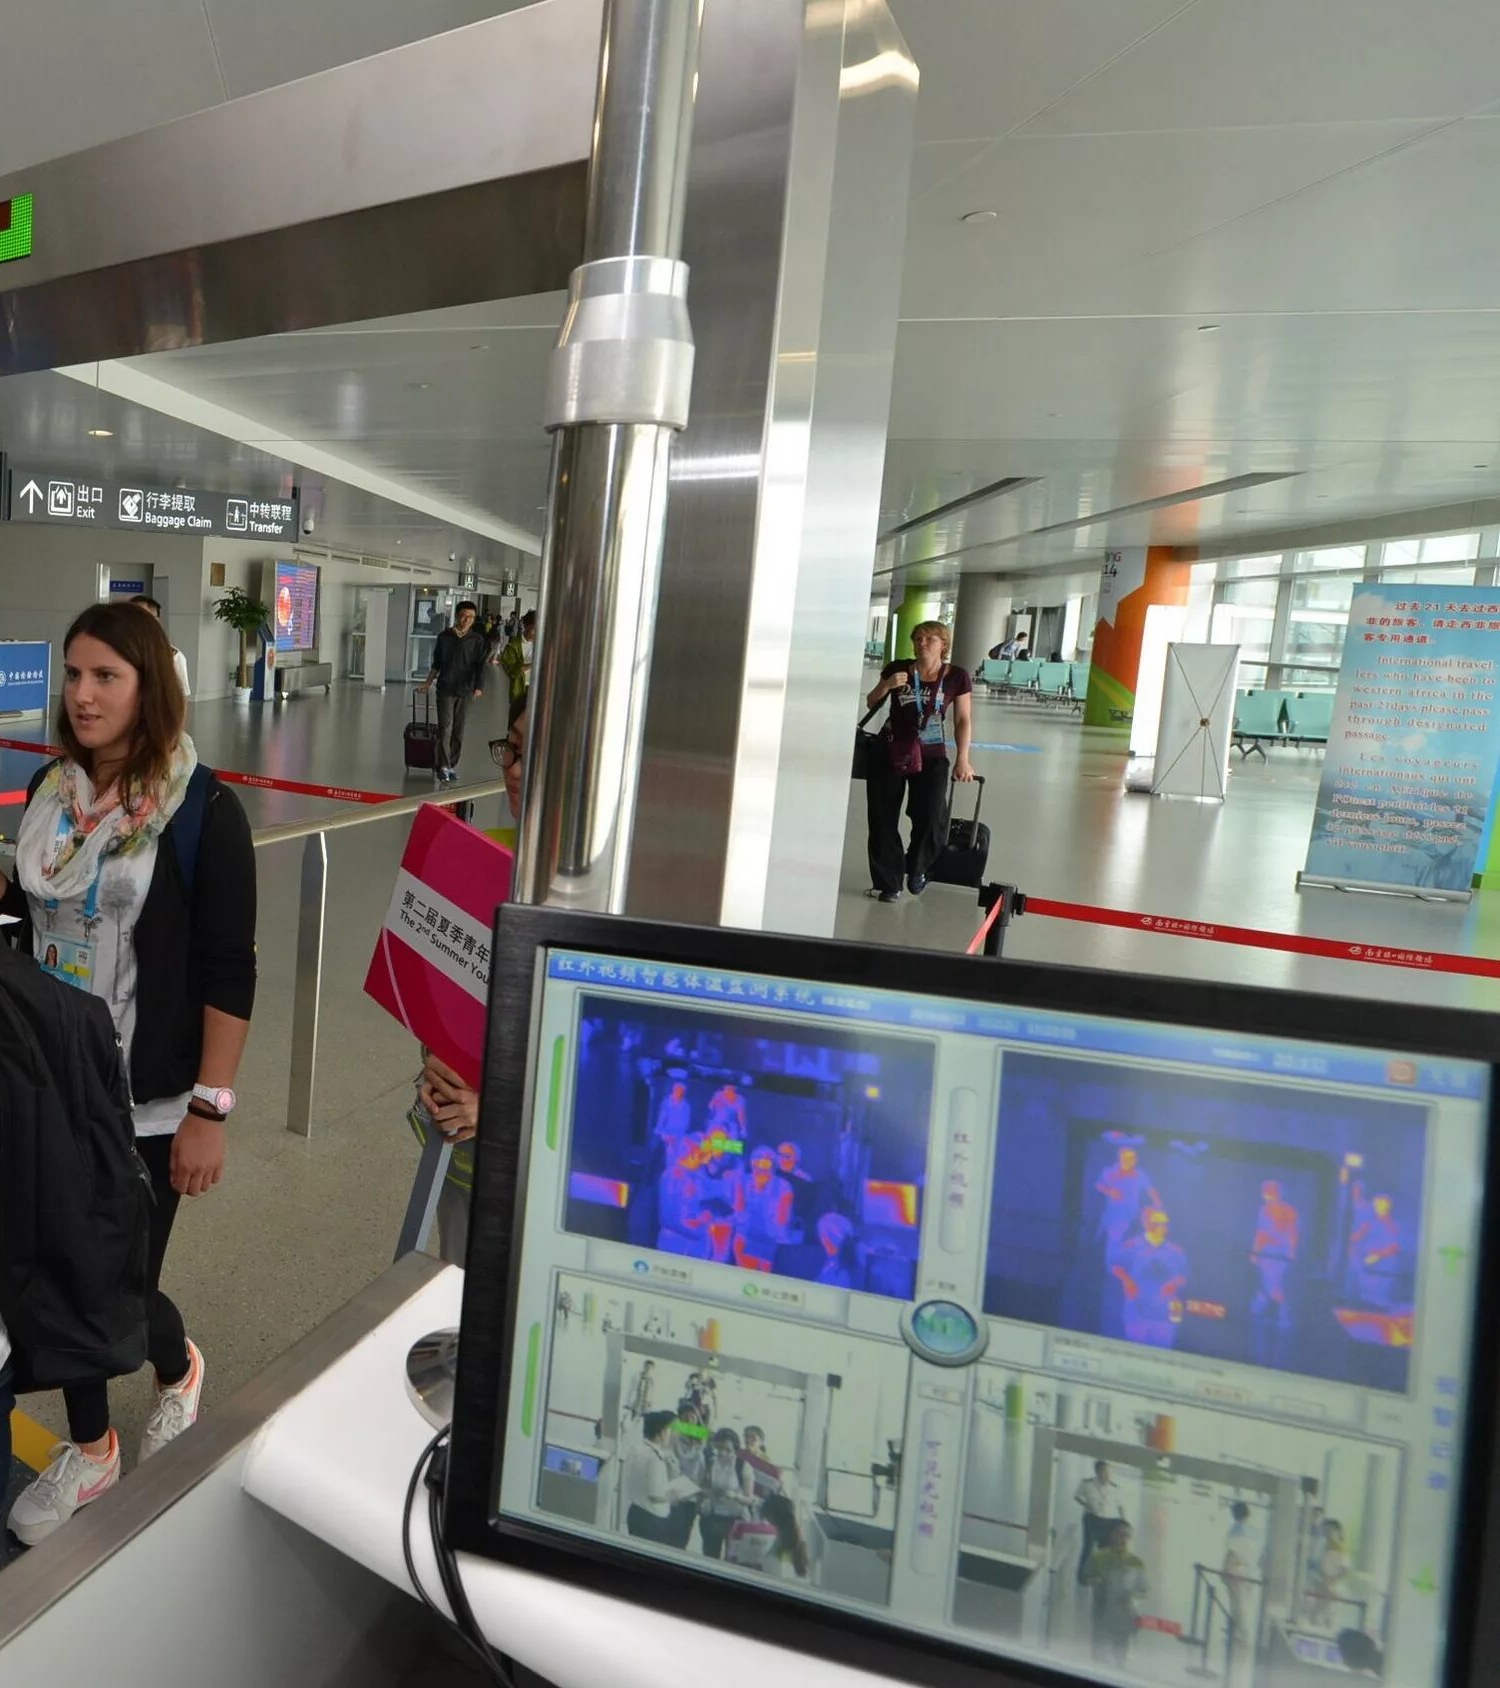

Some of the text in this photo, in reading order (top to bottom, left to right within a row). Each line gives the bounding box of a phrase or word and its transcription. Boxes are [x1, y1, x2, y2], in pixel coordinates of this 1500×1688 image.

[77, 485, 103, 503] 出口
[145, 491, 196, 512] 行李提取
[77, 506, 96, 519] Exit
[249, 503, 292, 521] 中转联程
[145, 512, 212, 529] Baggage Claim
[249, 520, 283, 535] Transfer
[1378, 656, 1452, 669] International
[1413, 673, 1443, 683] have
[1483, 676, 1495, 685] to
[1471, 691, 1492, 701] the
[401, 909, 415, 928] The
[430, 934, 468, 968] Summer
